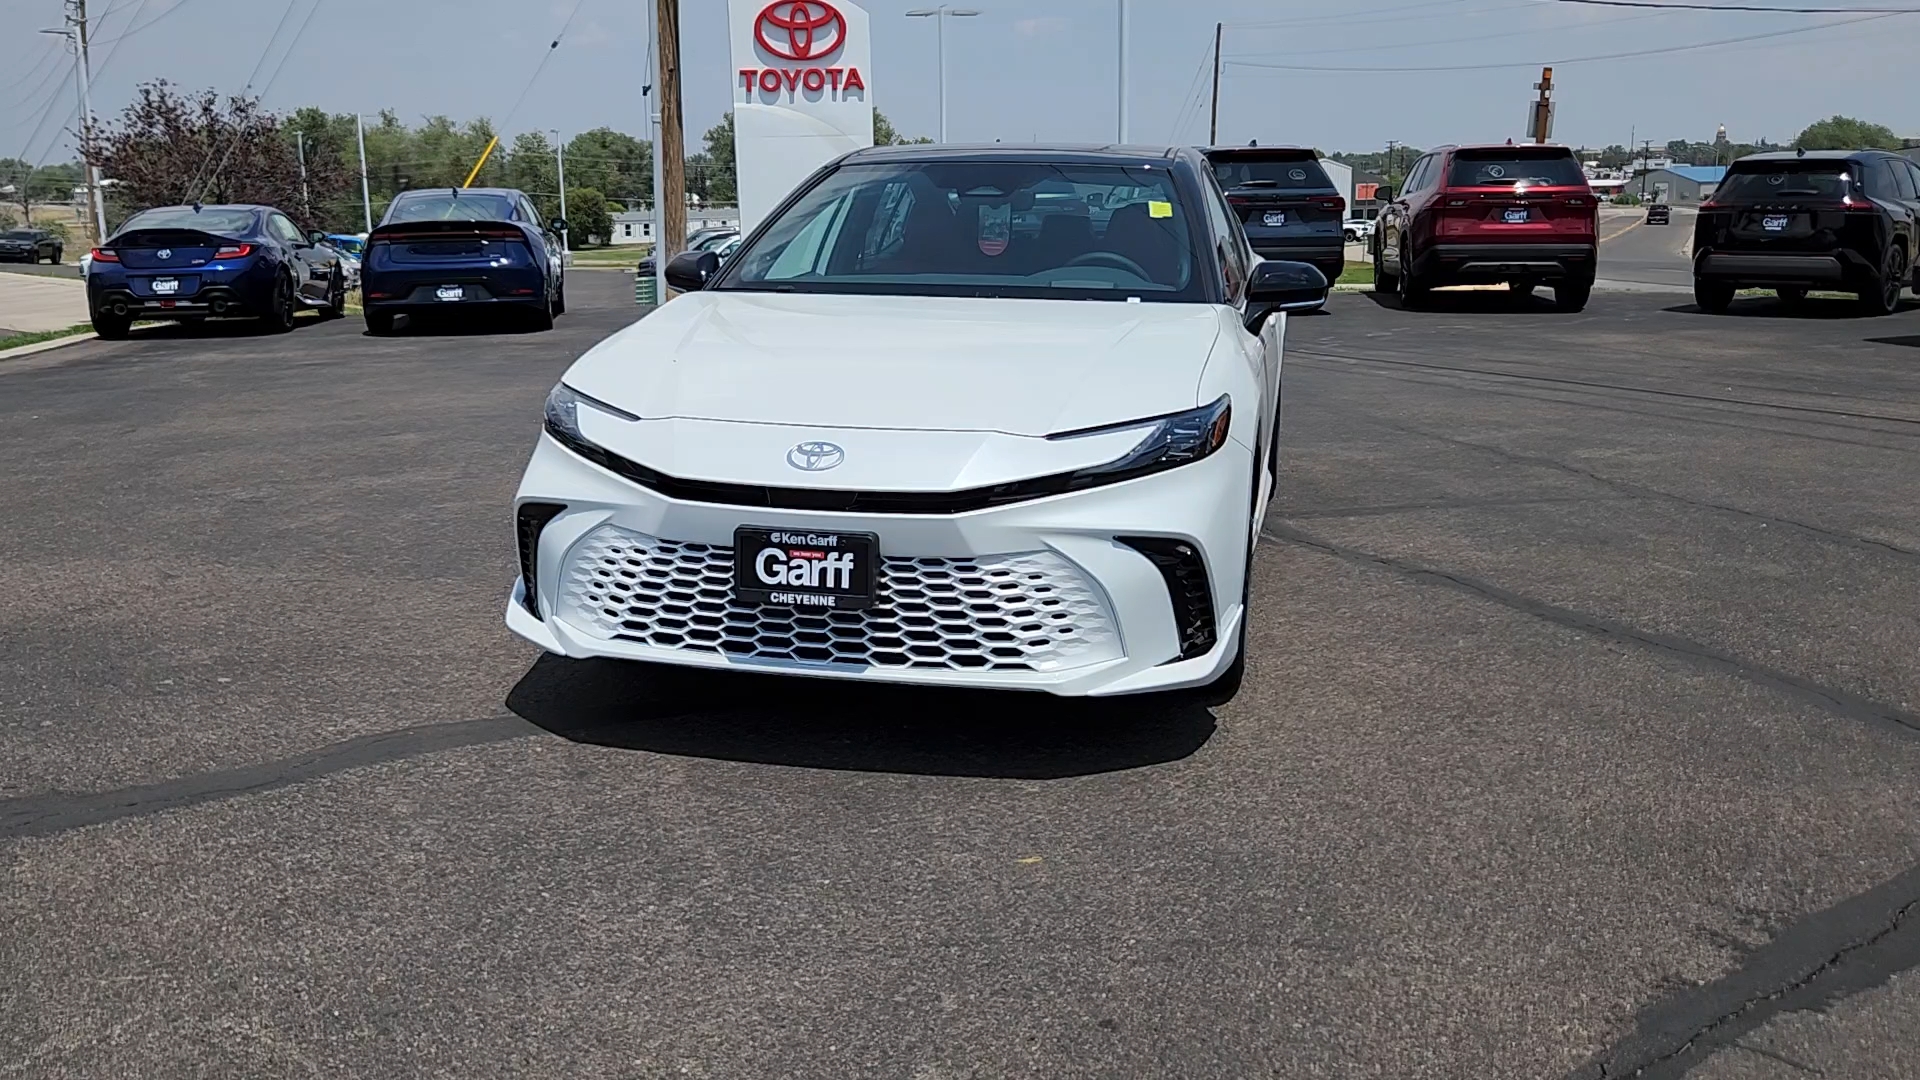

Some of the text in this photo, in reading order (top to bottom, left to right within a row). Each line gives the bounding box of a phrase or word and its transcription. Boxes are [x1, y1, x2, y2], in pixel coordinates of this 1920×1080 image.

[739, 68, 865, 92] TOYOTA
[1263, 213, 1285, 223] Garff
[1504, 210, 1528, 220] Garff
[1762, 217, 1788, 227] Garff
[152, 280, 179, 290] Garff
[436, 287, 463, 297] Garff
[782, 532, 838, 546] Ken Garff
[755, 547, 854, 589] Garff
[770, 592, 836, 607] CHEYENNE
